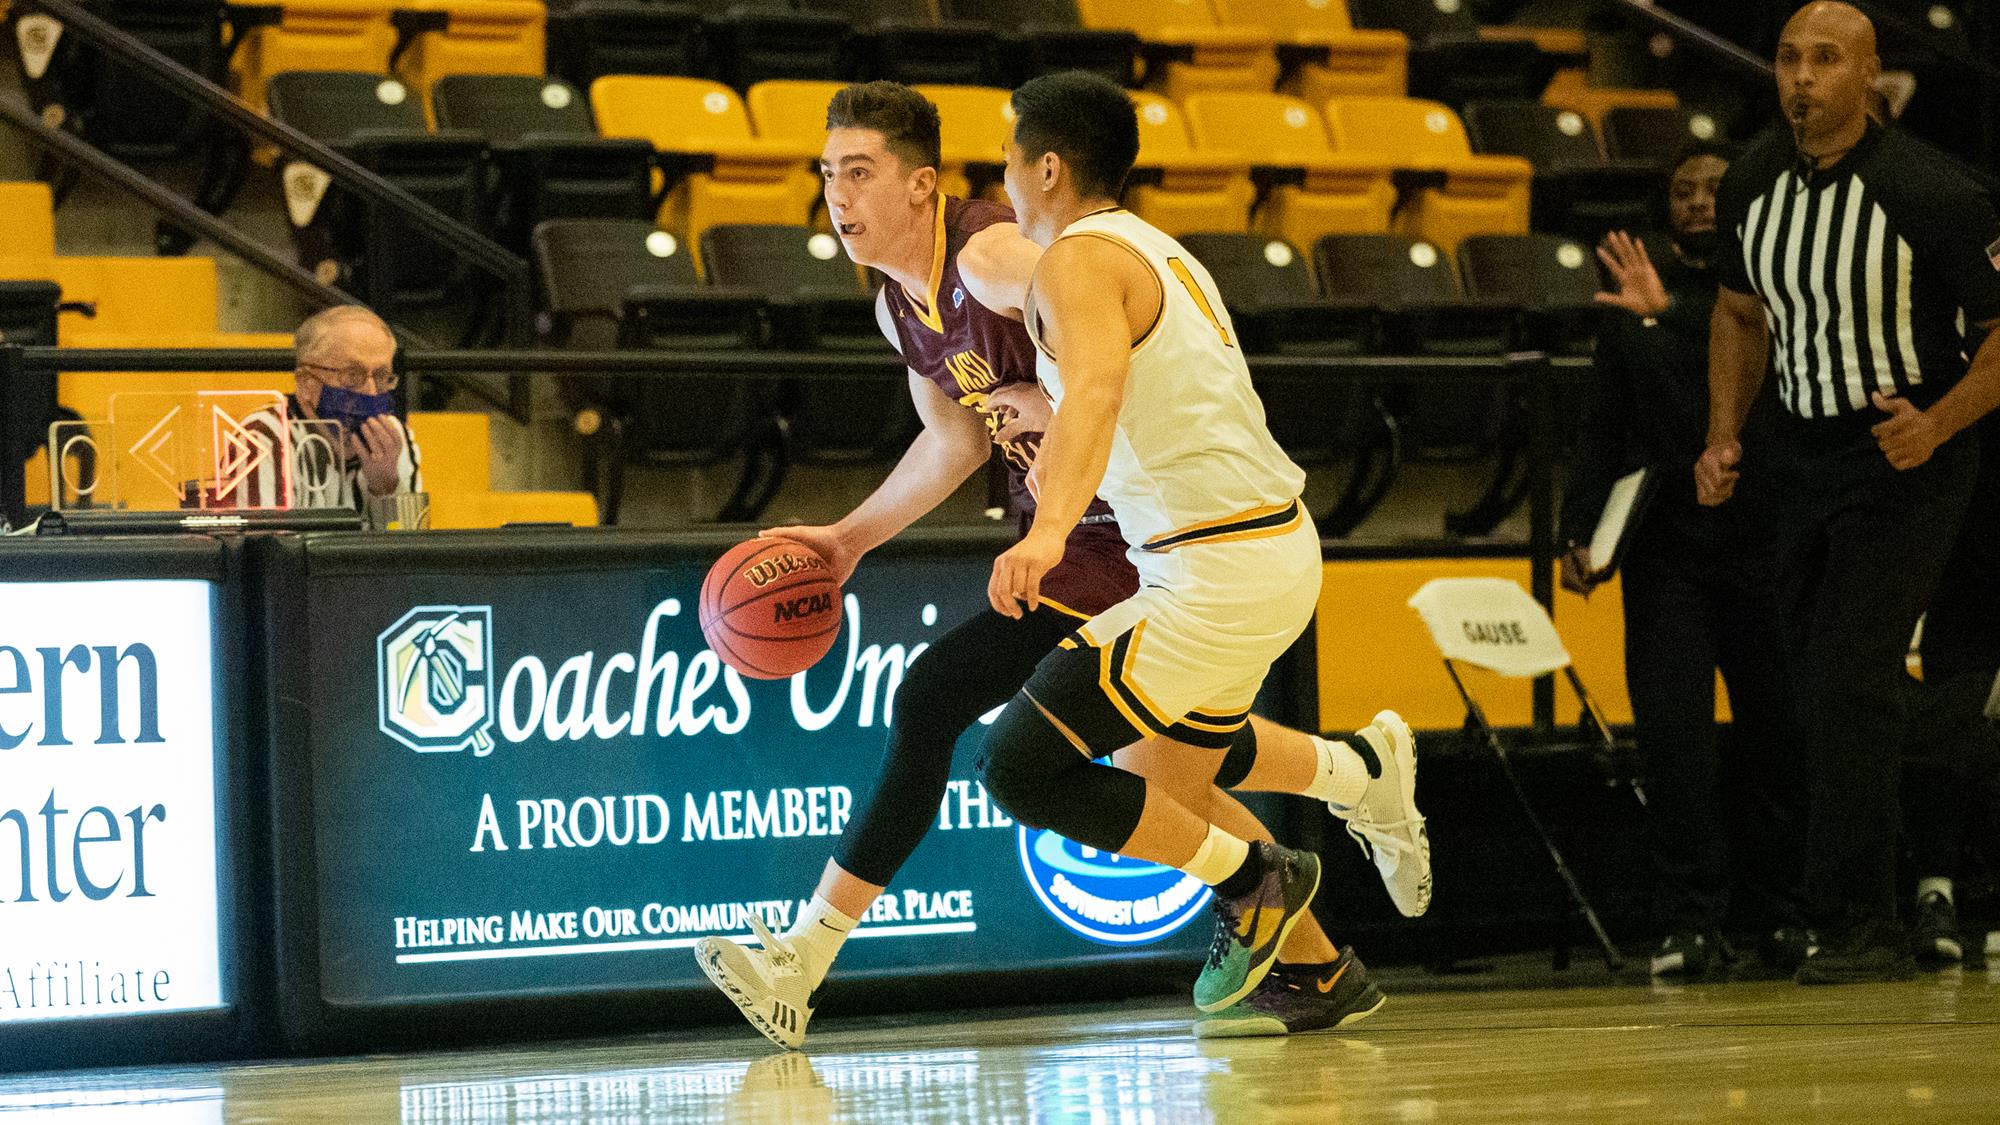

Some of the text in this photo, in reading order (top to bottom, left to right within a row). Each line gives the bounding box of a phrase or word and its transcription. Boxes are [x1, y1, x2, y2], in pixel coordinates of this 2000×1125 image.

[1166, 256, 1234, 349] 1
[945, 349, 1000, 396] MSU
[742, 553, 829, 588] Wilson
[774, 591, 833, 624] NCAA
[1462, 620, 1528, 646] GAUSE
[469, 792, 509, 852] A
[516, 793, 670, 849] PROUD
[681, 785, 852, 842] MEMBER
[0, 960, 170, 1009] Affiliate
